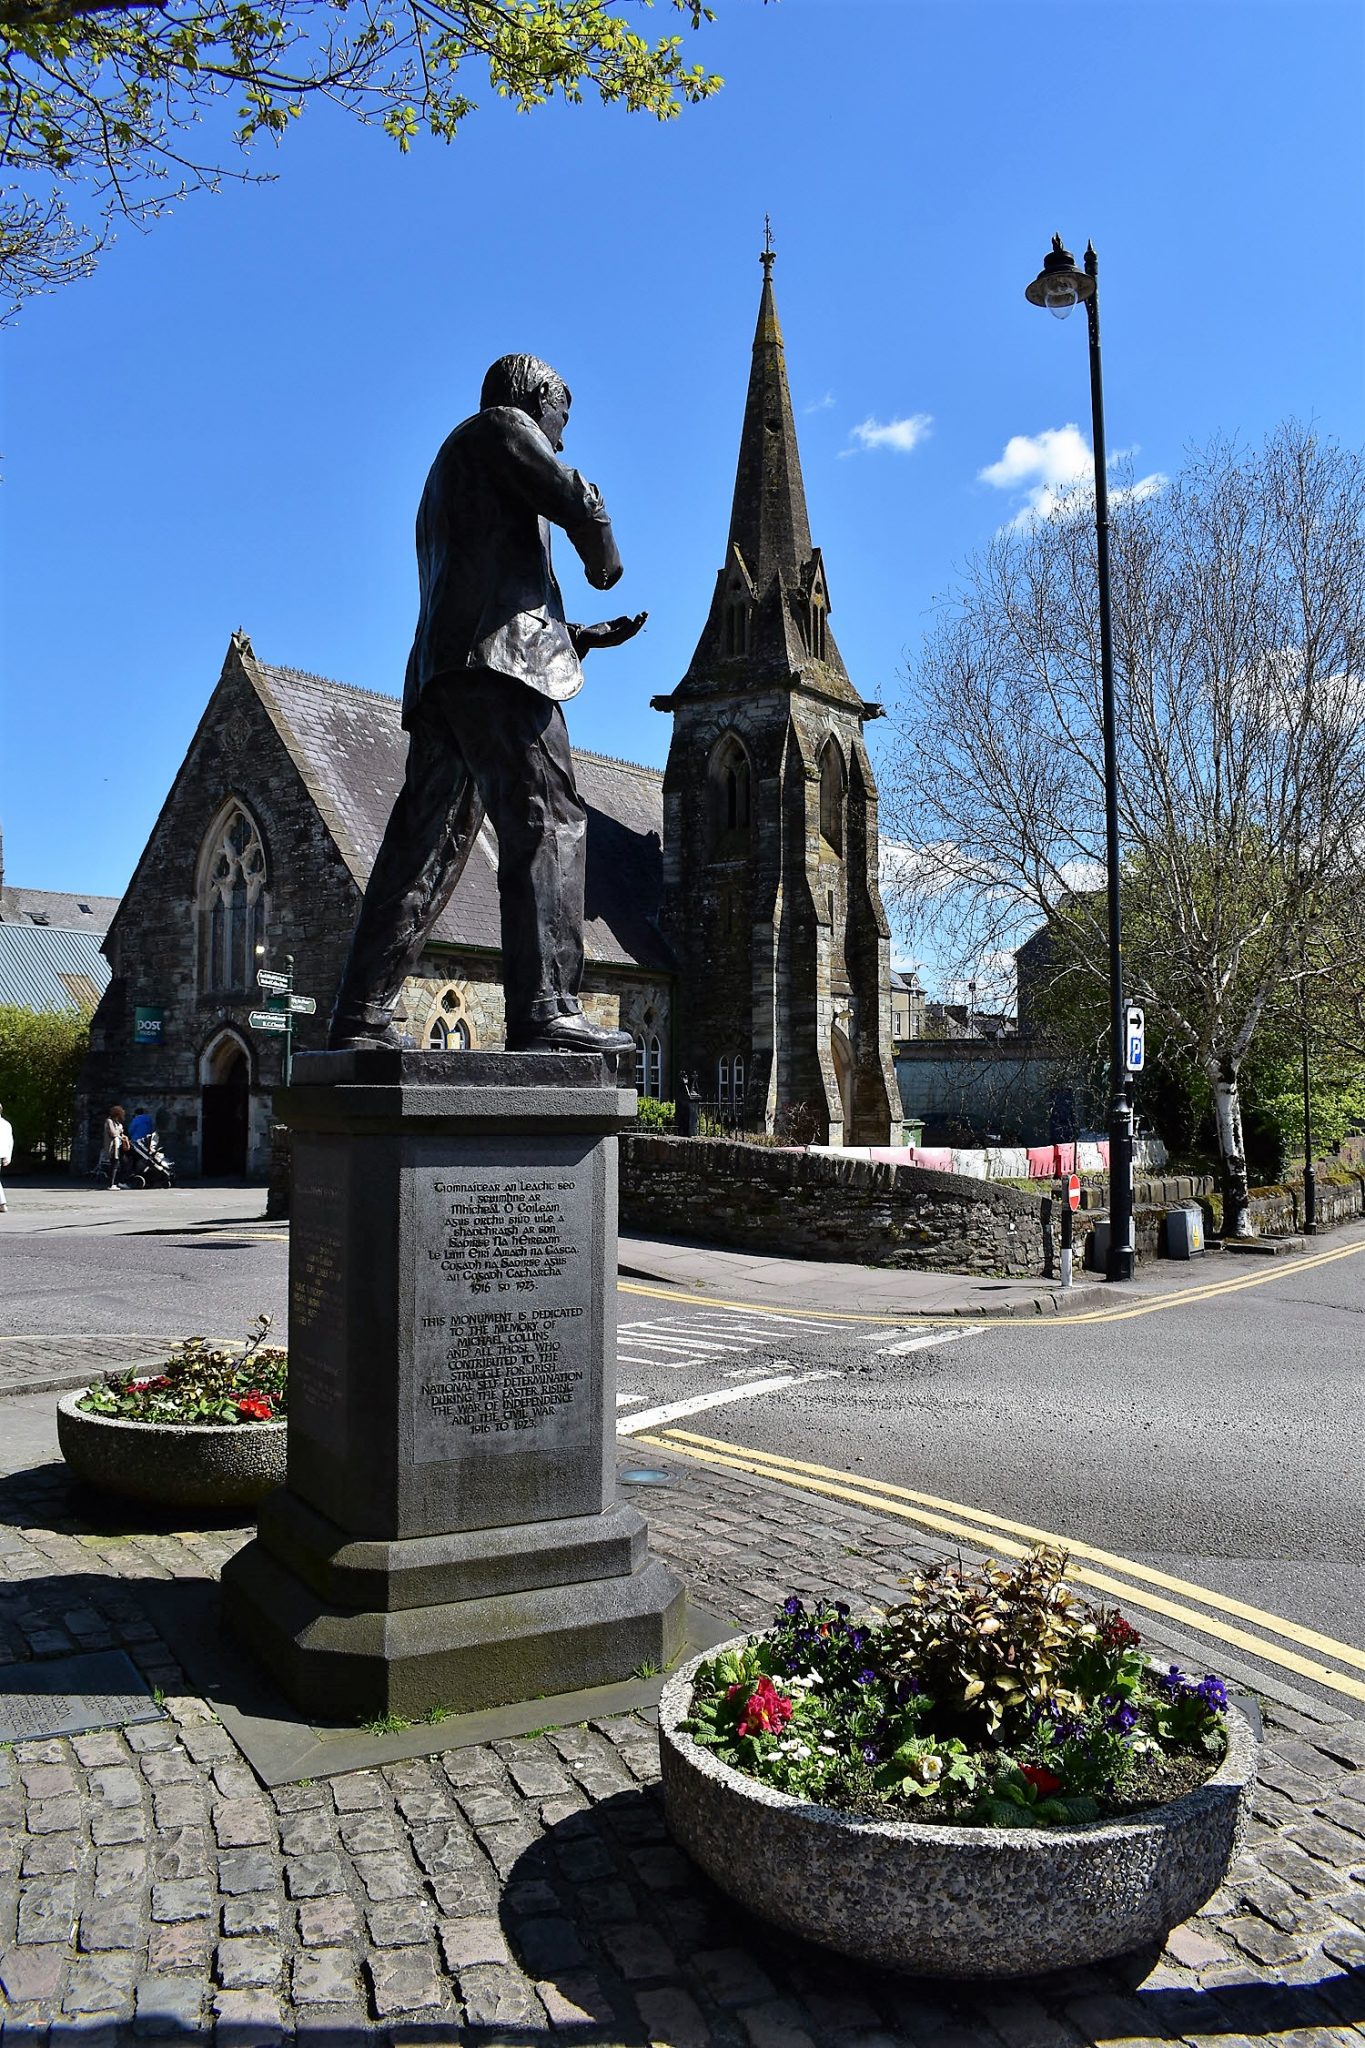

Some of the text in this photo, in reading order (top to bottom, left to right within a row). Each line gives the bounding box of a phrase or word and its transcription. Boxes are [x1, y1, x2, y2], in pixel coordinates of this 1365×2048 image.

[558, 1182, 575, 1190] seo
[445, 1218, 469, 1227] agus
[523, 1226, 535, 1234] ar
[538, 1225, 556, 1233] son
[501, 1258, 540, 1268] Saoirse
[544, 1257, 566, 1266] agus
[447, 1273, 459, 1281] an
[470, 1283, 491, 1294] 1916
[422, 1308, 583, 1327] THIS MONUMENT IS DEDICATED
[450, 1320, 556, 1336] TO THE MEMORY OF
[458, 1332, 548, 1347] MICHAEL COLLINS
[447, 1342, 560, 1359] AND ALL THOSE WHO
[448, 1353, 558, 1370] CONTRIBUTED TO THE
[451, 1363, 556, 1381] STRUGGLE FOR IRISH
[422, 1371, 582, 1394] NATIONAL SELF-DETERMINATION
[432, 1382, 574, 1405] DURING THE EASTER RISING
[433, 1394, 573, 1416] THE WAR OF INDEPENDENCE
[452, 1406, 555, 1425] AND THE CIVIL WAR
[471, 1424, 490, 1434] 1916
[495, 1422, 509, 1432] TO
